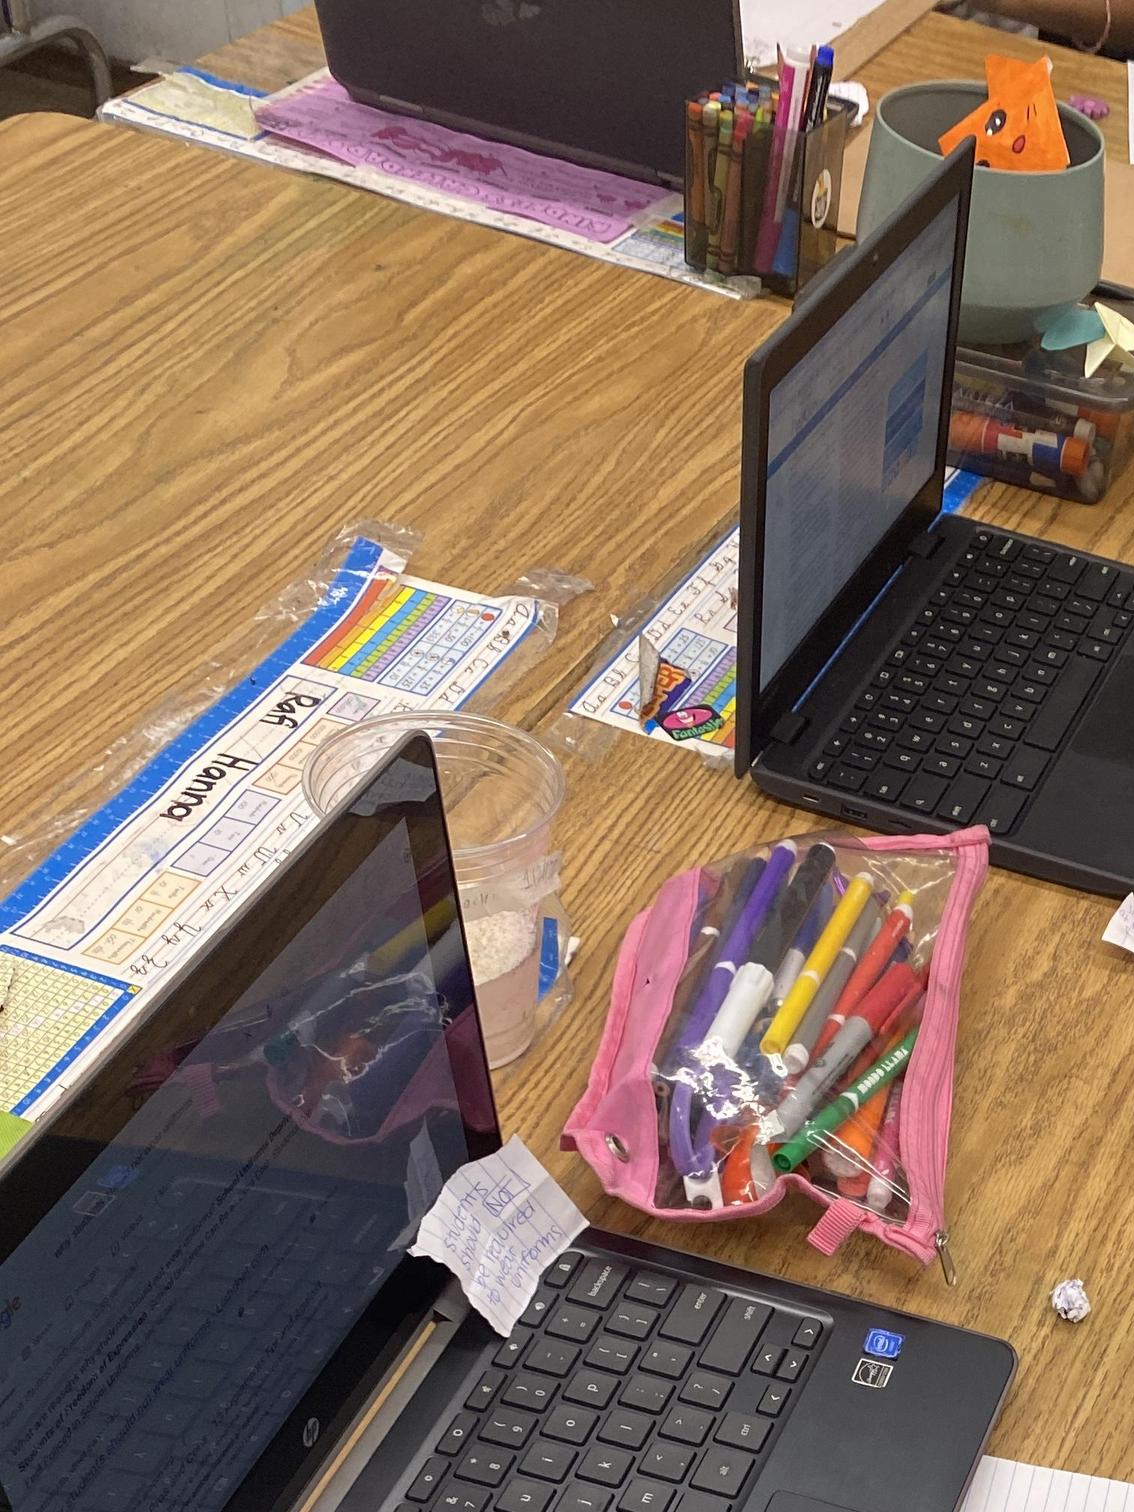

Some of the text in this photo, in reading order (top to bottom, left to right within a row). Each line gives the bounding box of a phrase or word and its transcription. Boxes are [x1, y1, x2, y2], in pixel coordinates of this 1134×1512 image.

[259, 691, 322, 729] Rafi
[159, 753, 259, 822] Hanna
[694, 1292, 708, 1310] enter
